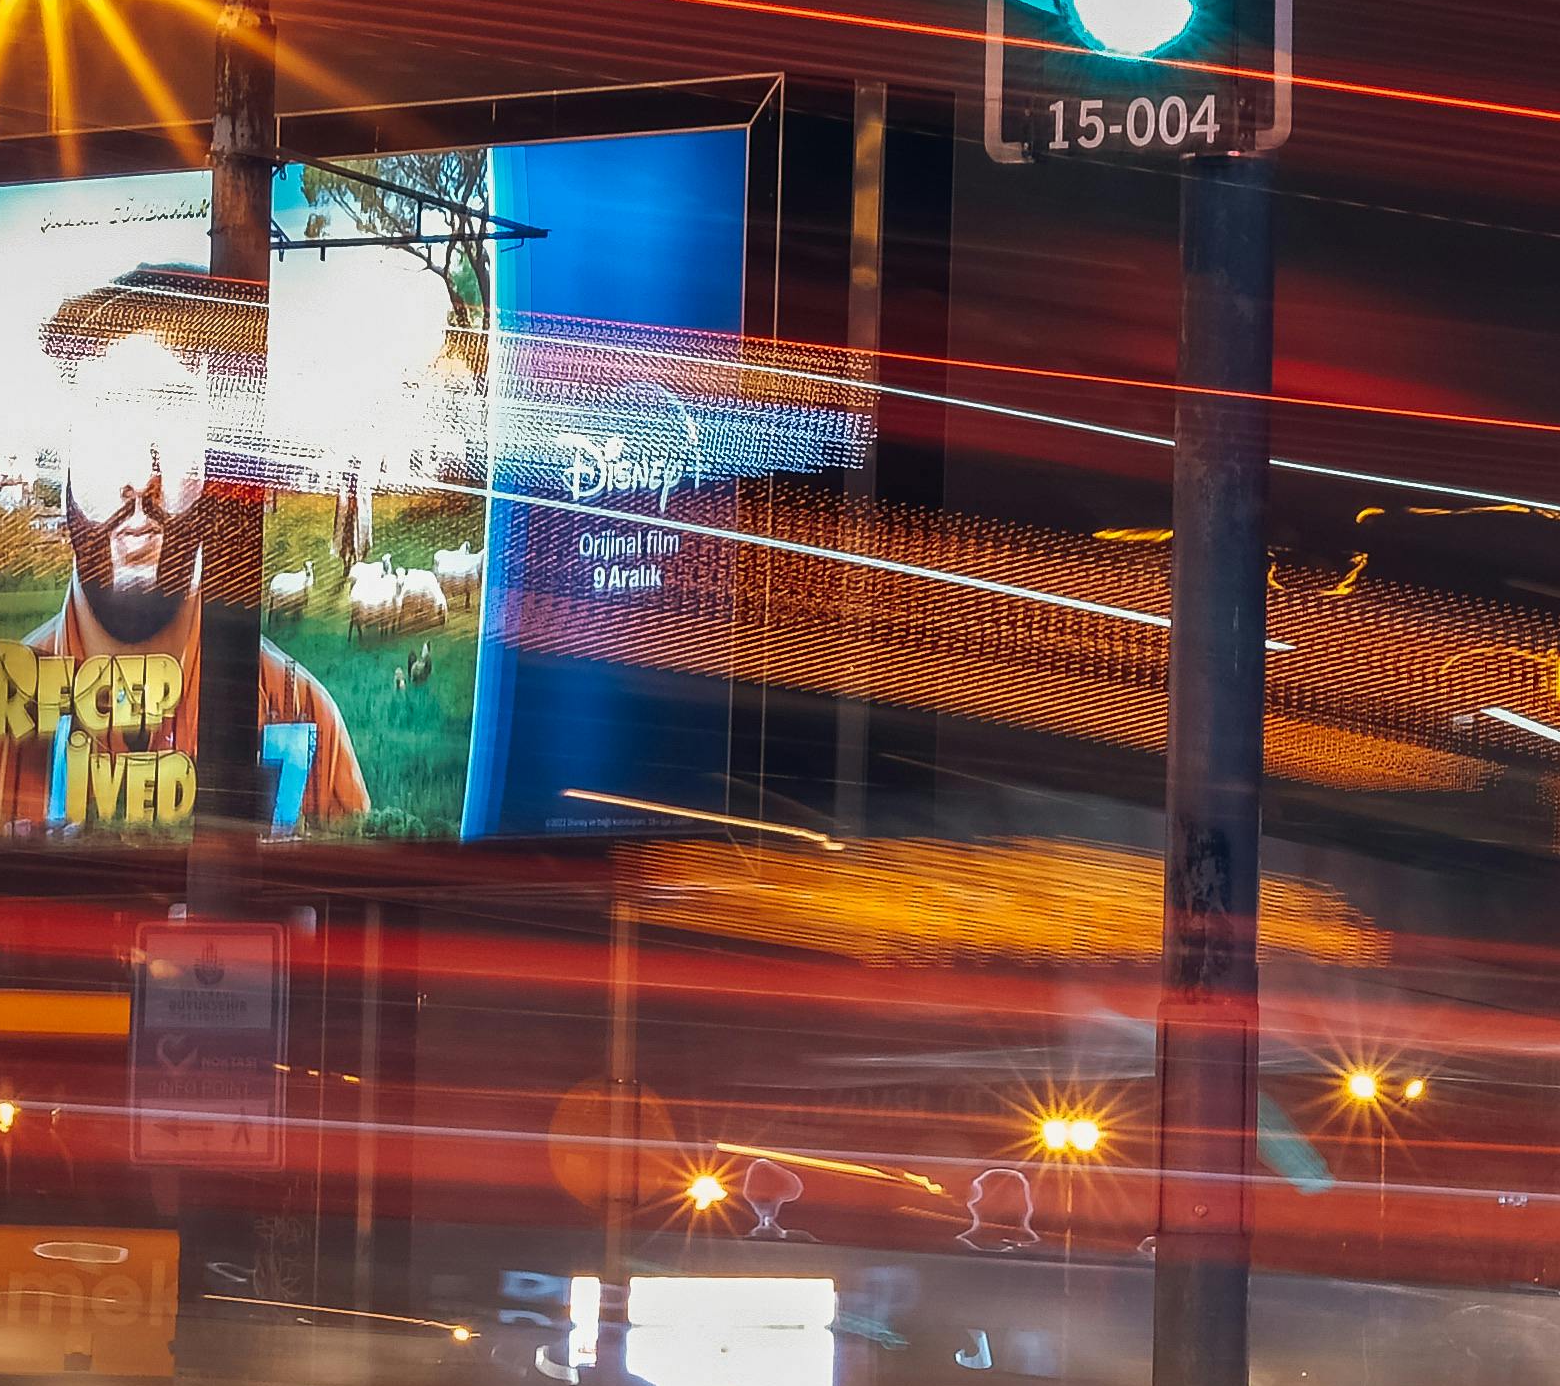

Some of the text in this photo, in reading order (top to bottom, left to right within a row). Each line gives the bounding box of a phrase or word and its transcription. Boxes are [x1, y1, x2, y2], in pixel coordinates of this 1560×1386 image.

[1049, 94, 1221, 150] 15-004
[579, 529, 679, 560] Orijinal film
[593, 564, 663, 589] 9 Aralık
